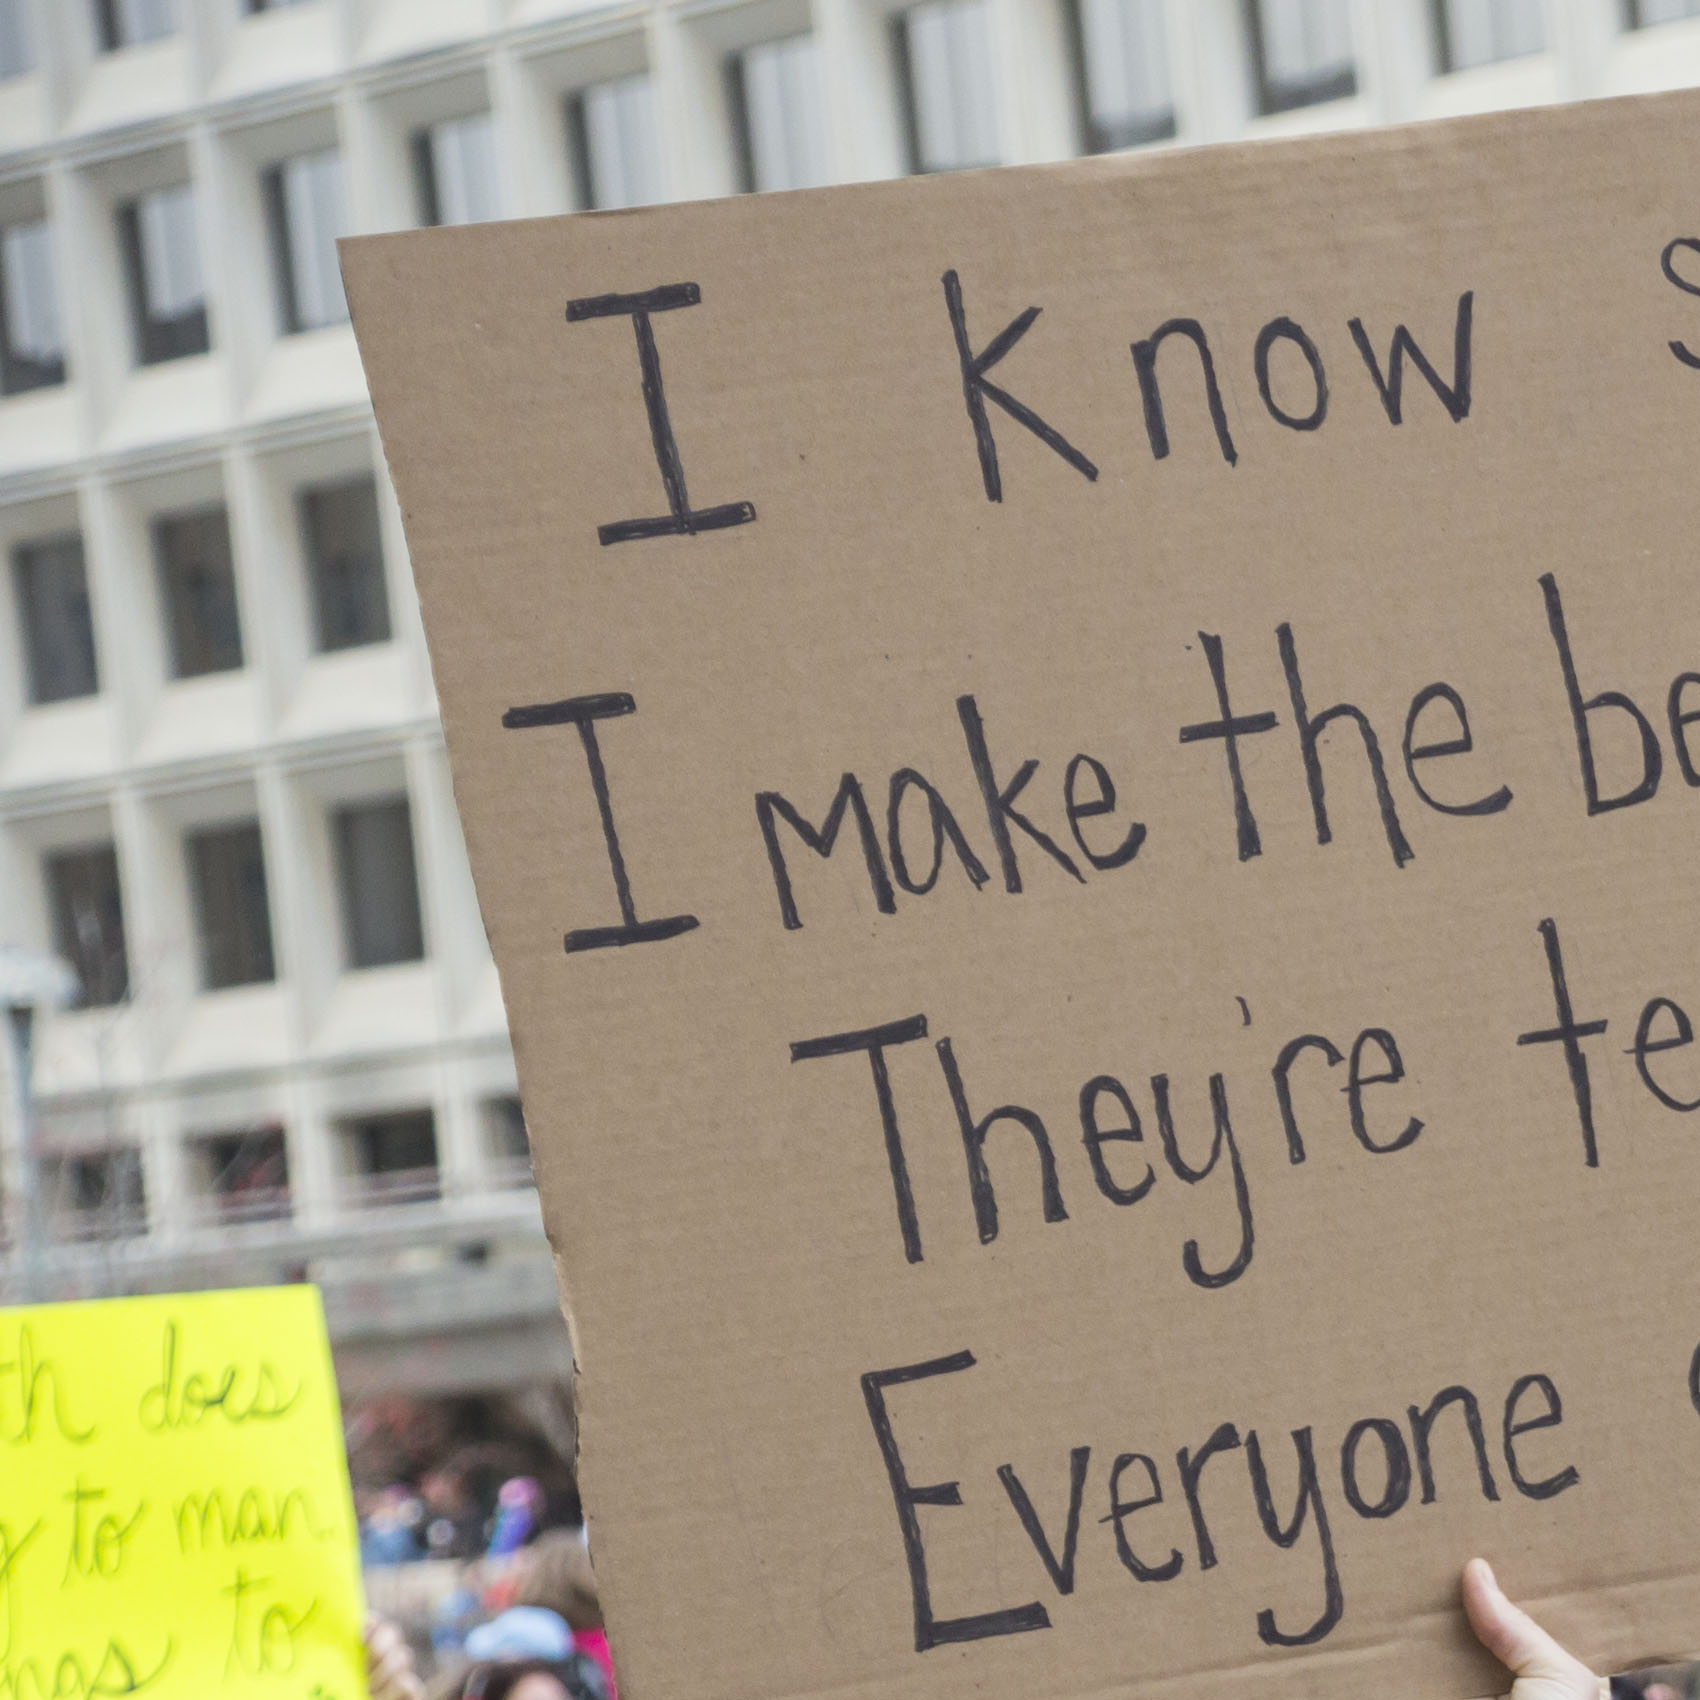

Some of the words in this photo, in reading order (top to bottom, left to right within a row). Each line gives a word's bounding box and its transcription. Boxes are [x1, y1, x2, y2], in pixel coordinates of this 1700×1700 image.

[564, 280, 758, 548] I
[939, 268, 1475, 505] know
[500, 690, 702, 955] I
[753, 694, 1149, 932] make
[1178, 621, 1515, 871] the
[787, 995, 1427, 1292] They're
[859, 1348, 1582, 1655] Everyone
